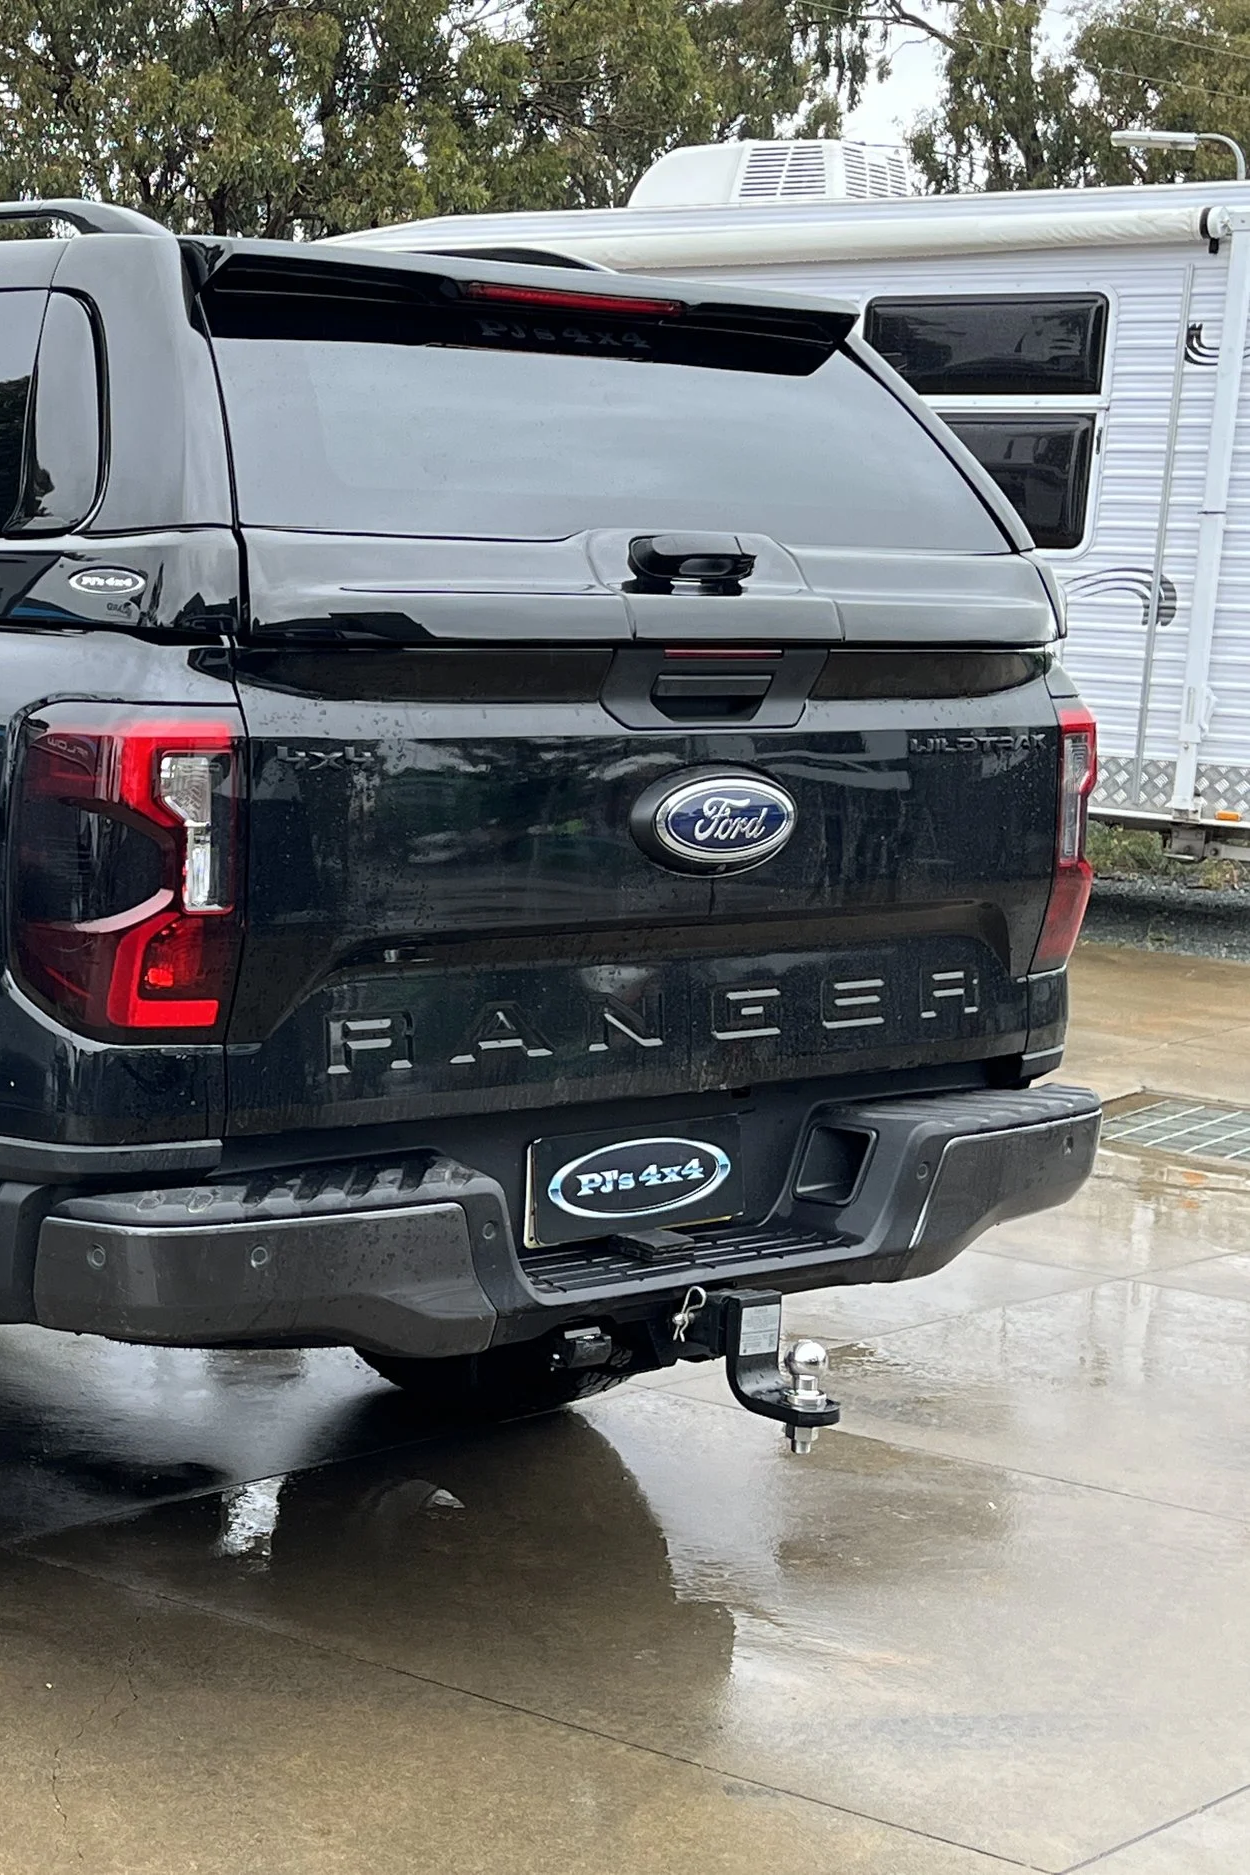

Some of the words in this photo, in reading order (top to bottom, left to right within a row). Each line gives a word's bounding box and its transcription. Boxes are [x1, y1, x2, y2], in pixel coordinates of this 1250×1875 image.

[910, 733, 1047, 753] WILDTRAK
[694, 796, 768, 841] Ford
[326, 967, 979, 1074] RANGER
[576, 1169, 636, 1197] PJ's
[638, 1158, 705, 1186] 4x4
